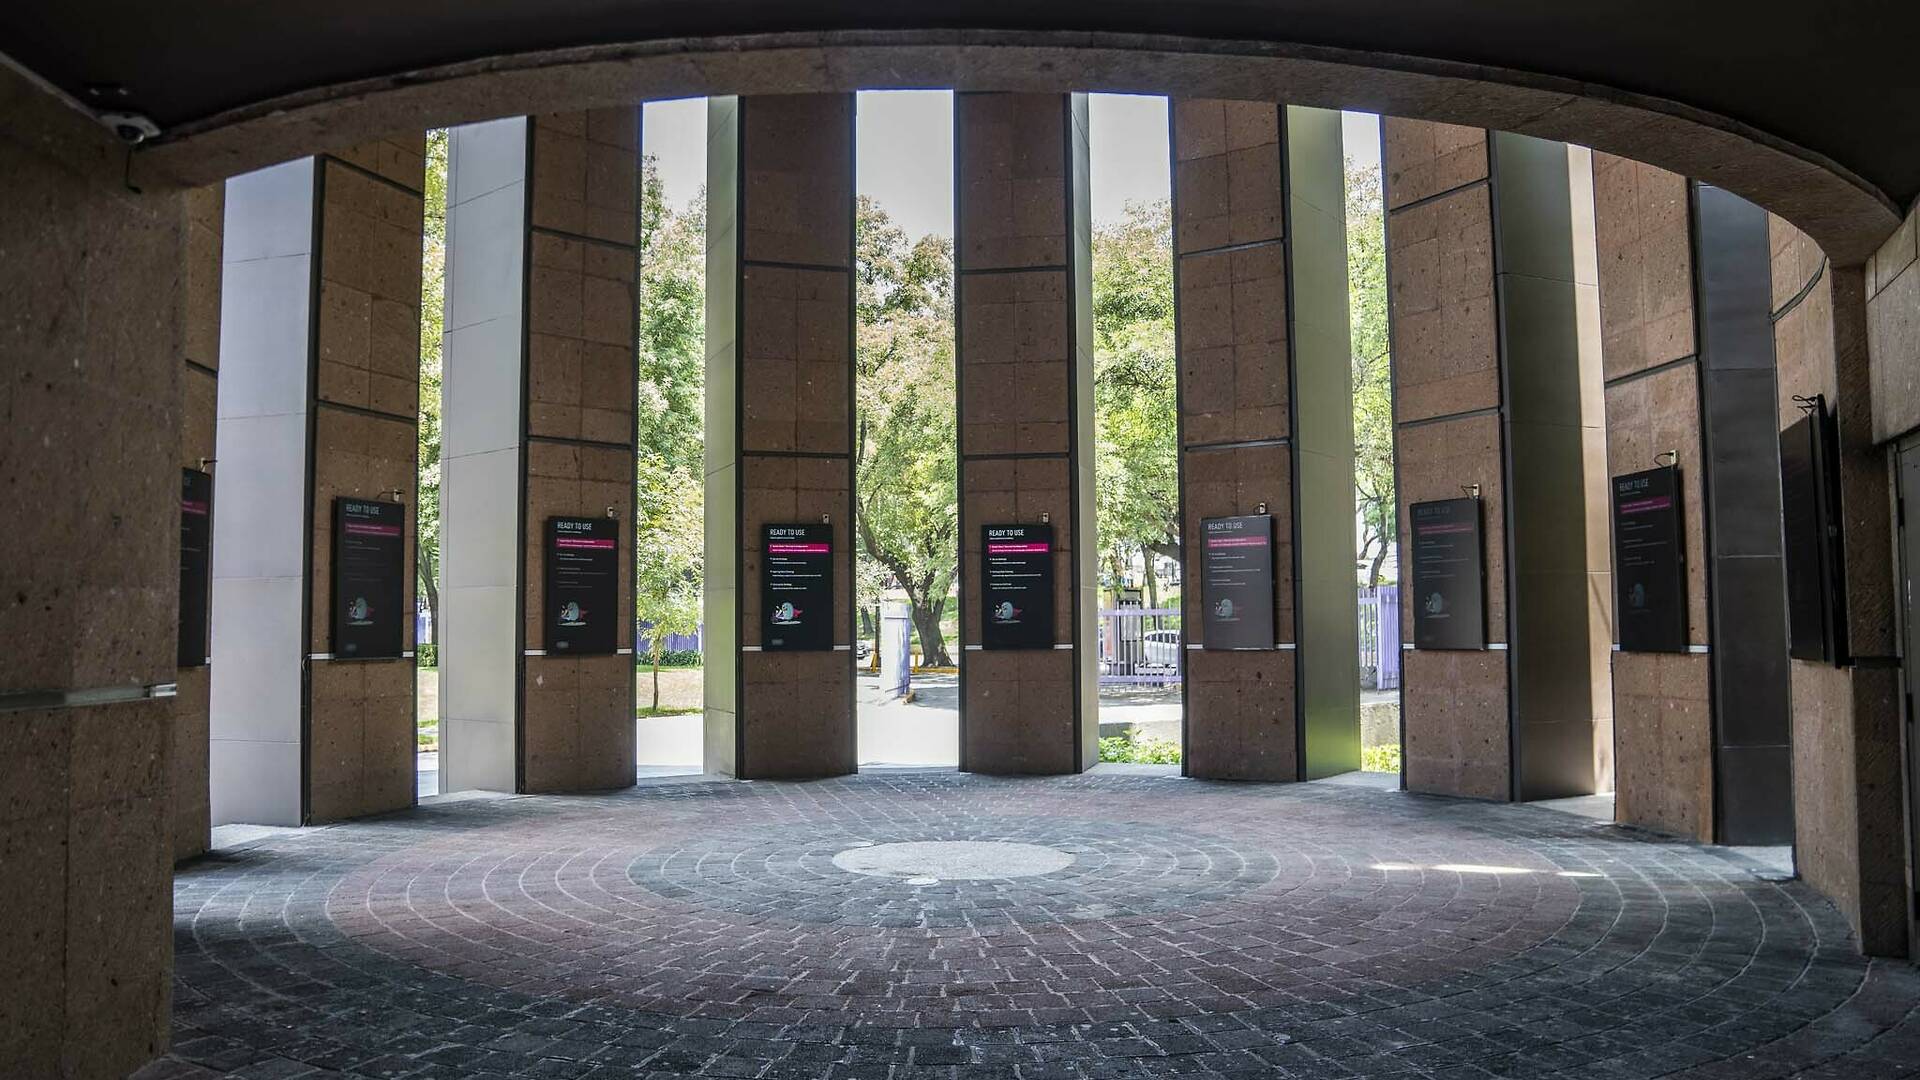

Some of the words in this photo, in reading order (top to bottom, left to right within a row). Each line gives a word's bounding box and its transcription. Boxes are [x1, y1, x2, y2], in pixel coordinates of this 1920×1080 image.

[557, 521, 574, 529] READY
[575, 522, 582, 530] TO
[769, 528, 786, 536] READY
[787, 528, 795, 536] TO
[988, 529, 1006, 537] READY
[1006, 529, 1013, 537] TO
[1013, 529, 1025, 537] USE
